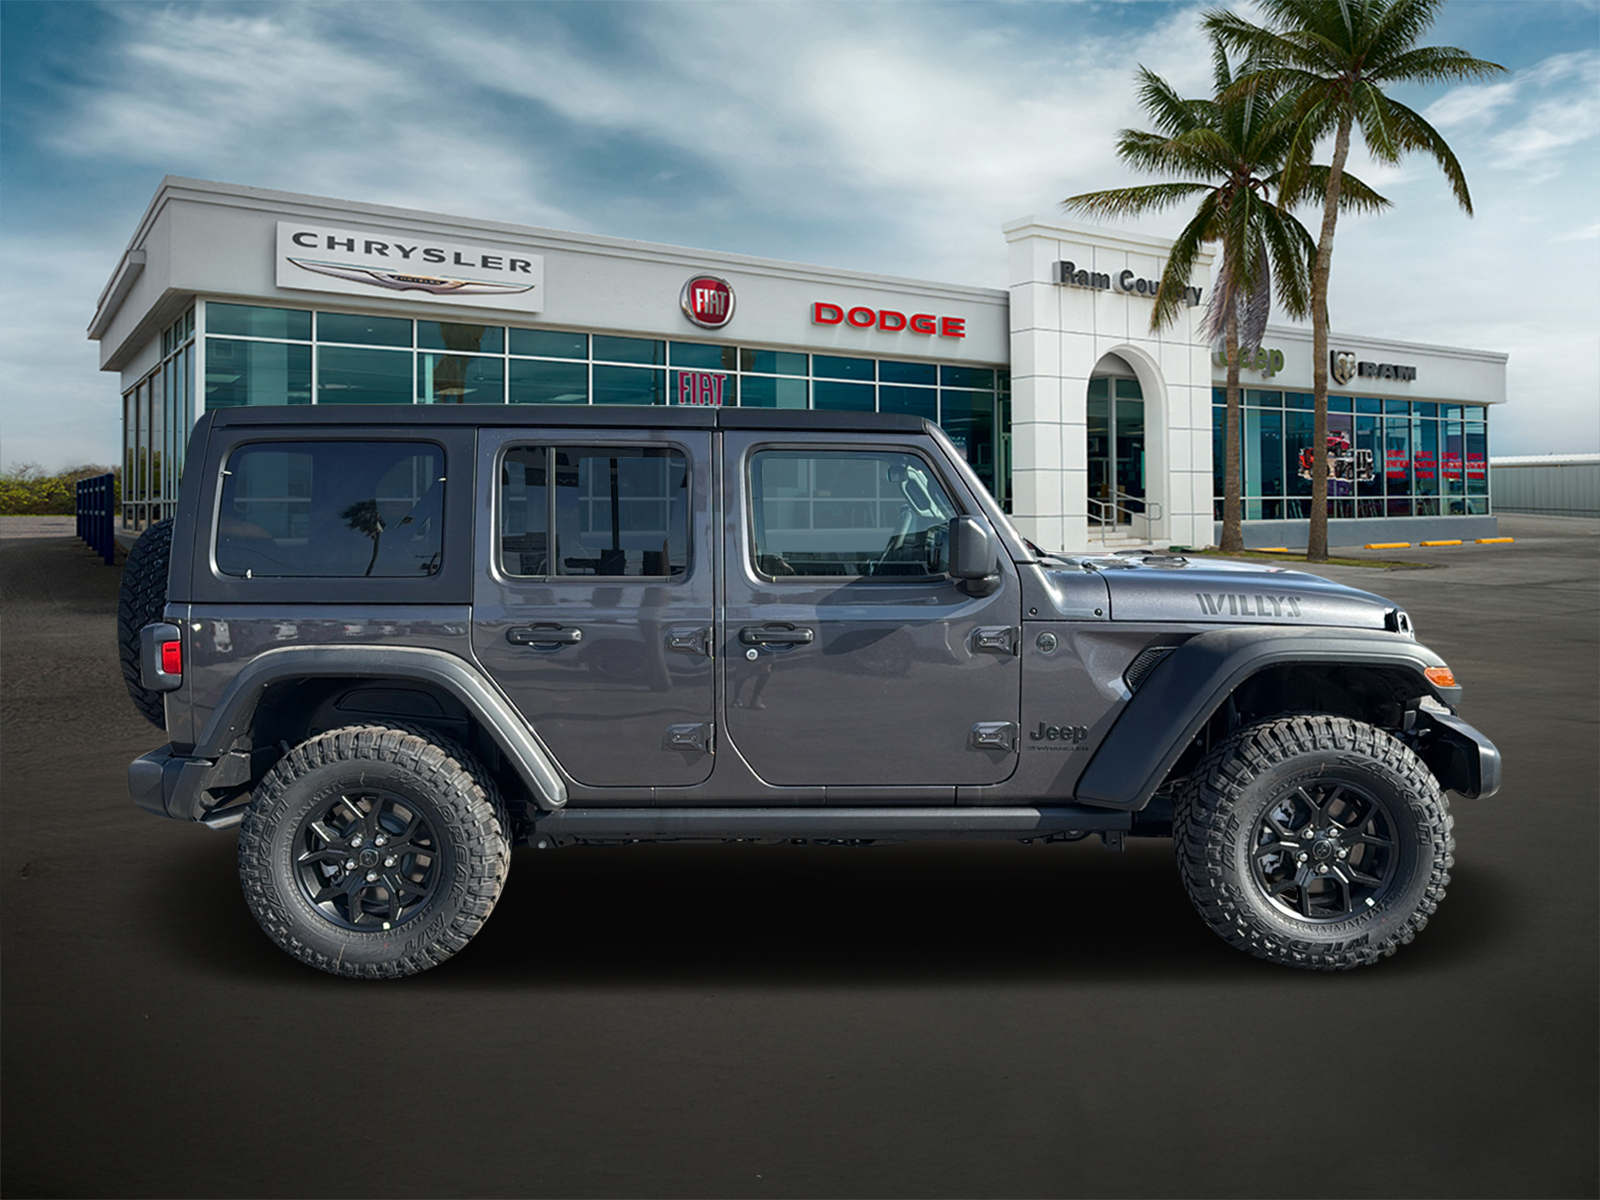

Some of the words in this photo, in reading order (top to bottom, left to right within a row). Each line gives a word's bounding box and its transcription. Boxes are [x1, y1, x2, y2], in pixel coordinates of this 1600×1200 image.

[291, 231, 532, 273] CHRYSLER
[1052, 260, 1111, 291] Ram
[1112, 269, 1203, 308] Coury
[694, 287, 728, 317] FIAT
[811, 301, 966, 339] DODGE
[1358, 361, 1417, 381] RAM
[677, 371, 727, 406] FIAT
[1195, 592, 1302, 618] WILLYS
[1030, 721, 1088, 744] Jeep
